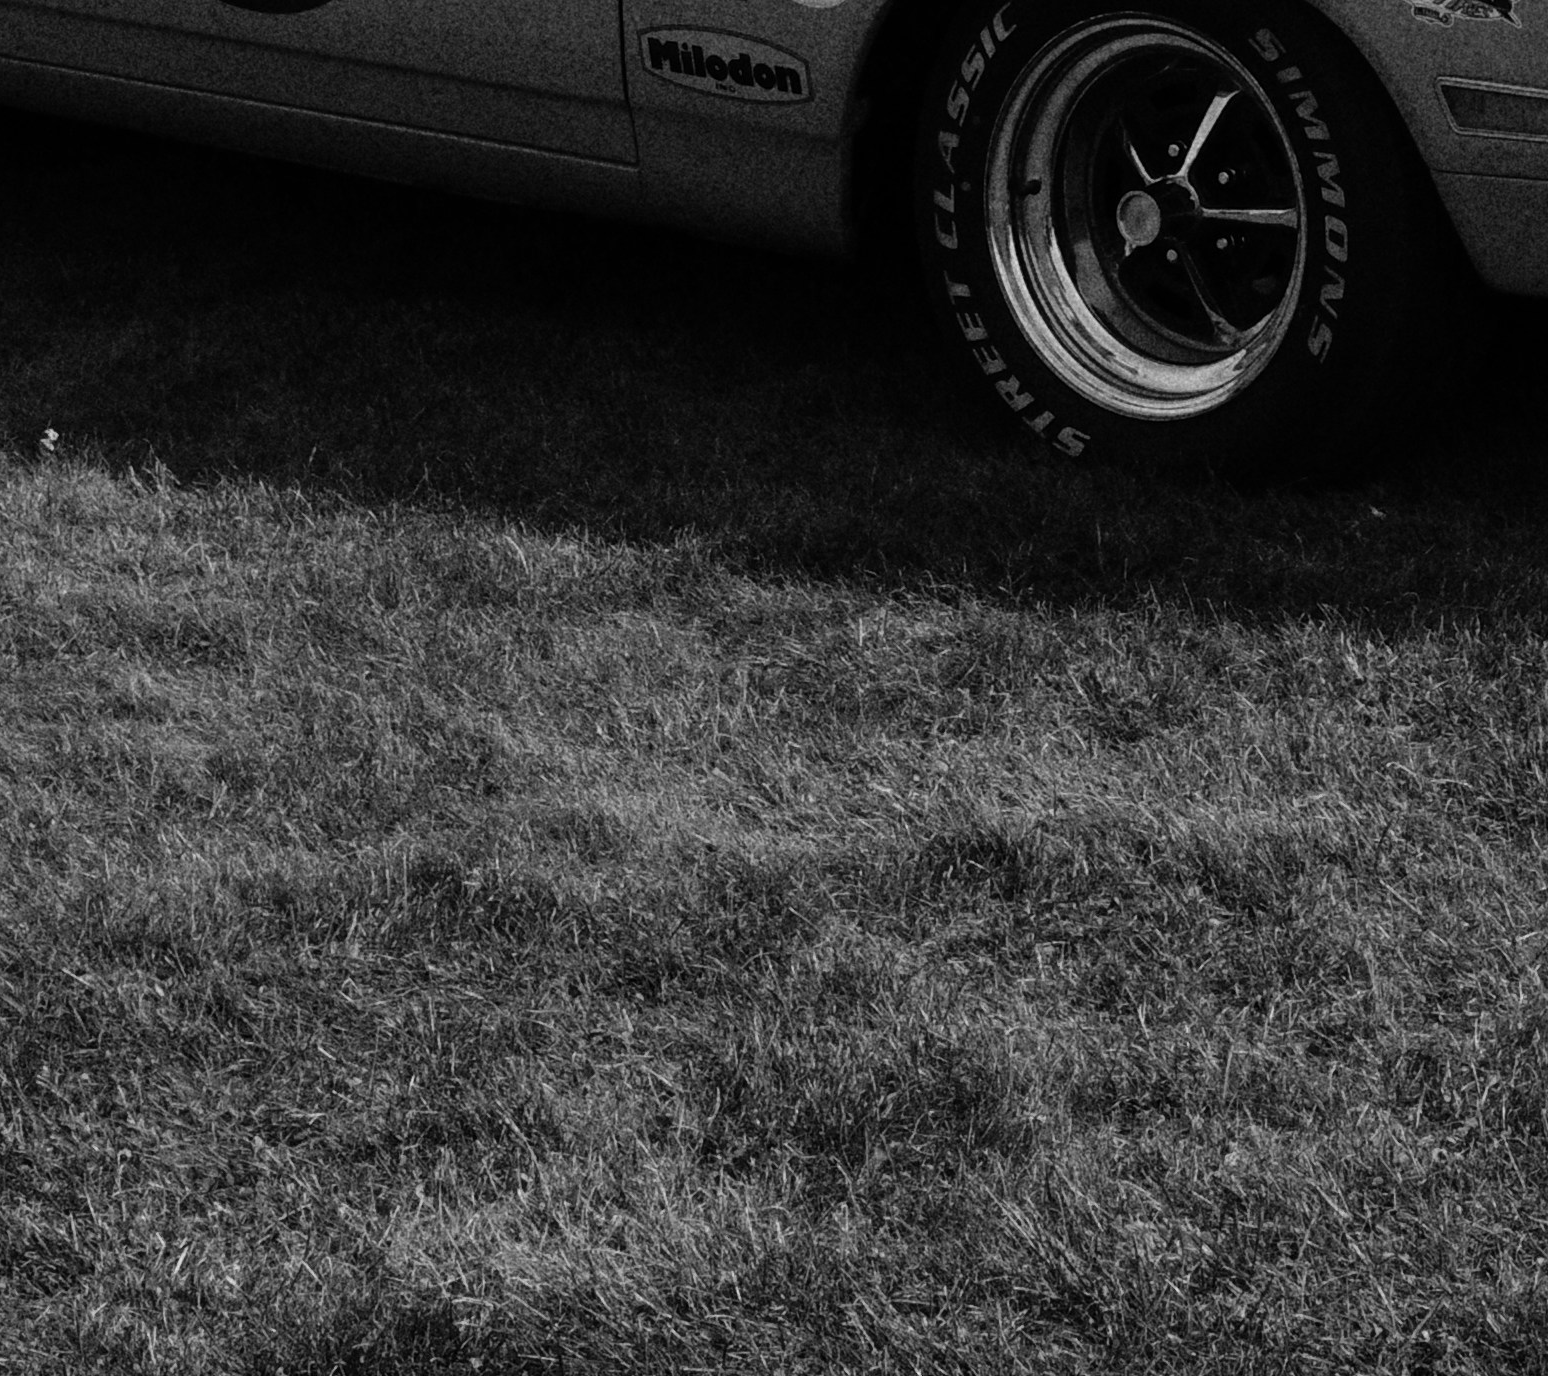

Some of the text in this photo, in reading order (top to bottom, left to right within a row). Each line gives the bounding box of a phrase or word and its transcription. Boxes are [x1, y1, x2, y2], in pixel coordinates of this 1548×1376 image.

[647, 37, 803, 95] Milodon
[933, 1, 1018, 249] CLASSIC
[1248, 27, 1349, 364] SIMMONS
[943, 269, 1092, 457] STREET
